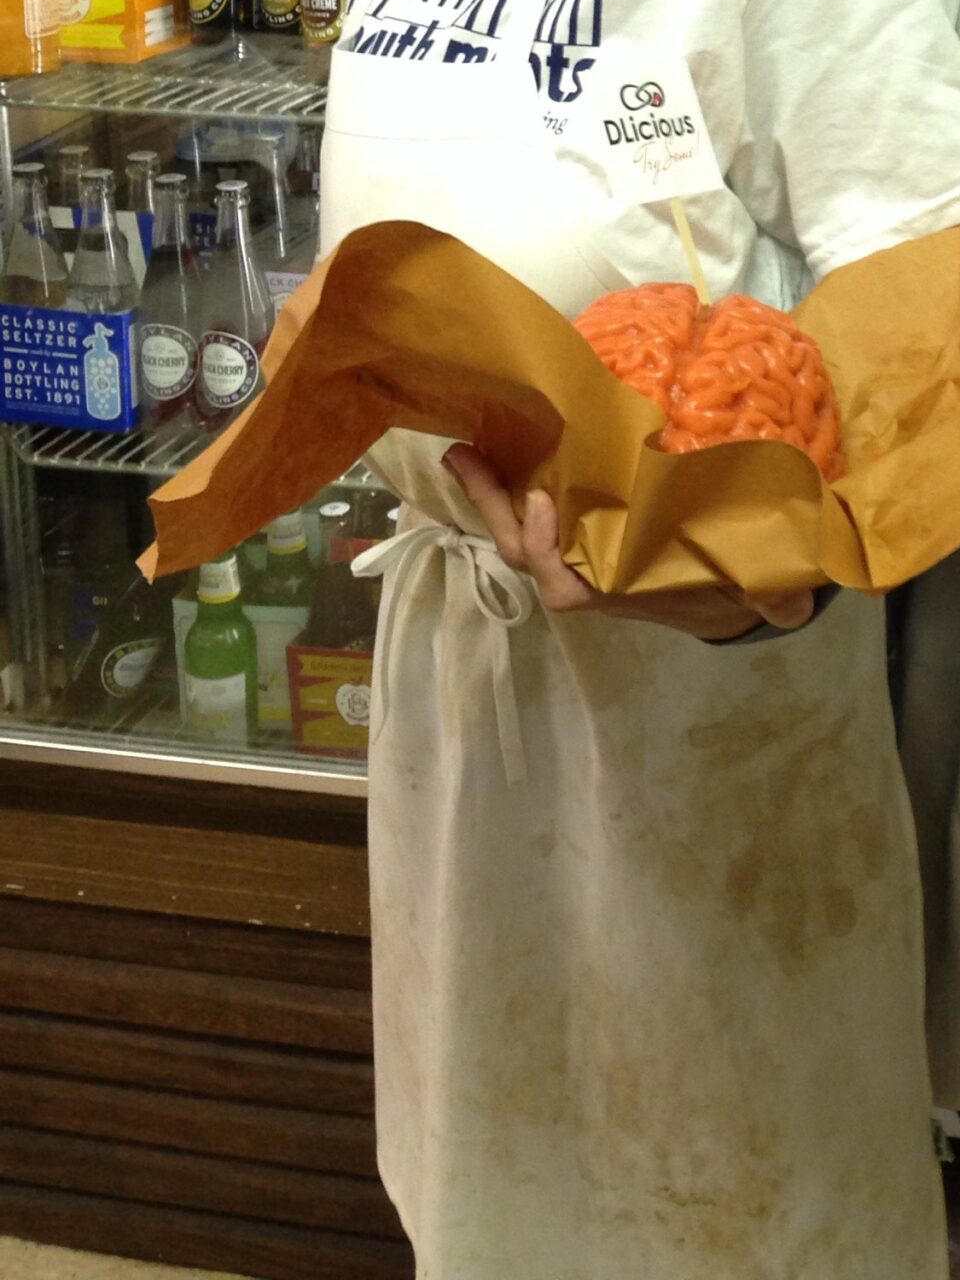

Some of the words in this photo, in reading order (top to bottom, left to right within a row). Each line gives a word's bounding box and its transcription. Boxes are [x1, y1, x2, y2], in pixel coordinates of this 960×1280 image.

[0, 314, 77, 334] CLASSIC
[1, 328, 77, 349] SELTZER
[3, 358, 79, 377] BOYLAN
[3, 372, 81, 391] BOTTLING
[4, 387, 39, 402] EST.
[45, 391, 81, 406] 1891
